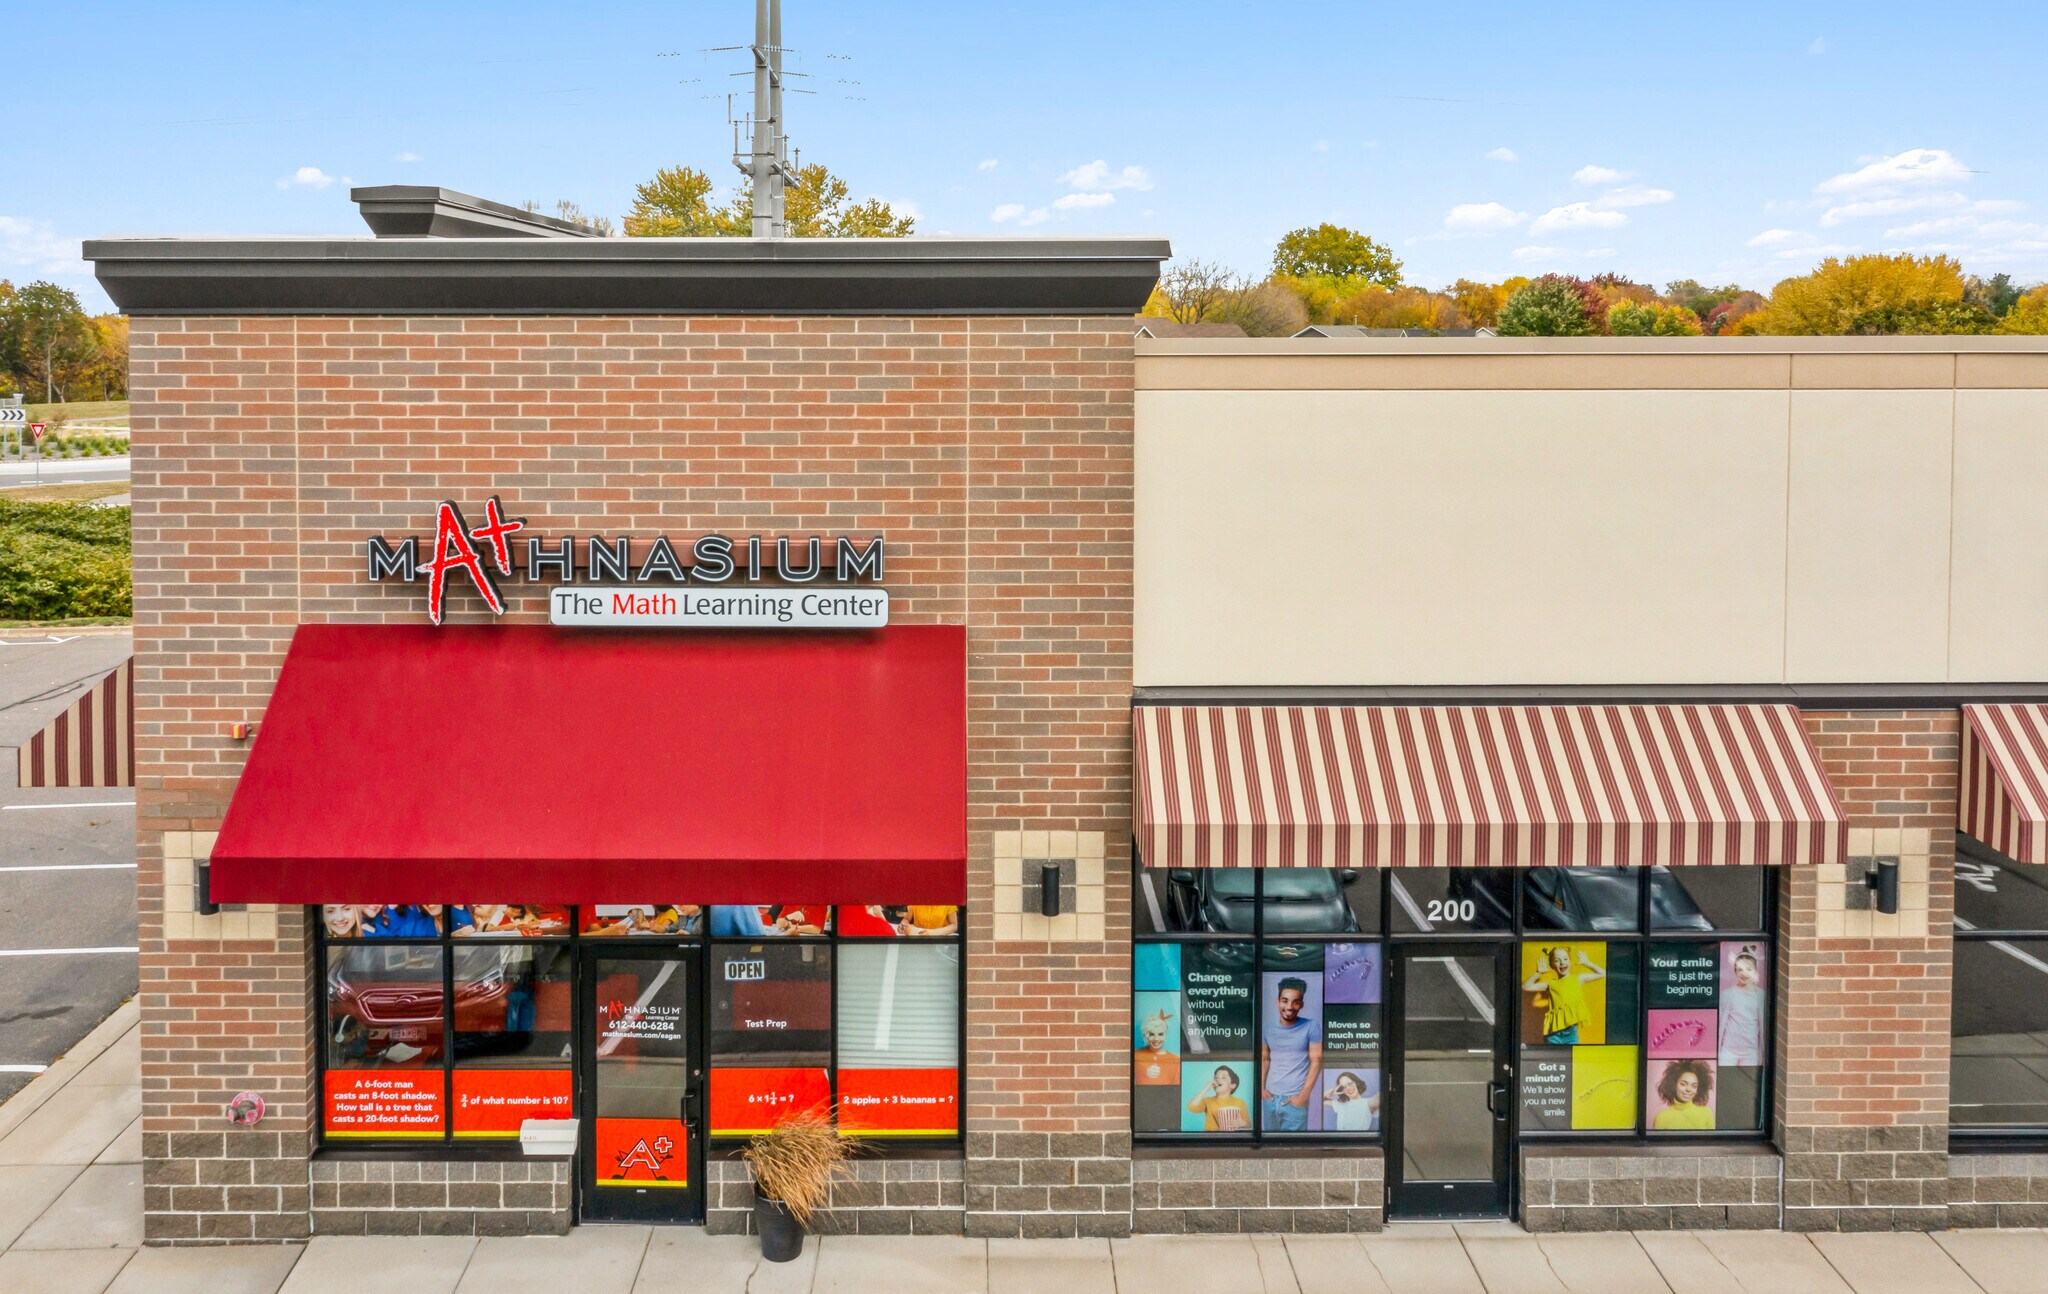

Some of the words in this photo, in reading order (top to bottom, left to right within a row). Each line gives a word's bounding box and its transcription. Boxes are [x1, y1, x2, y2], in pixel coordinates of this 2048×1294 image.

[555, 592, 603, 615] The
[611, 592, 677, 616] Math
[683, 593, 794, 622] Learning
[800, 594, 884, 616] Center
[1427, 899, 1475, 922] 200
[1651, 957, 1679, 968] Your
[1681, 957, 1714, 967] smile
[728, 962, 763, 979] OPEN
[1187, 972, 1233, 985] Change
[1668, 970, 1678, 981] is
[1678, 971, 1696, 983] just
[1697, 971, 1714, 981] the
[1187, 985, 1249, 998] everything
[1666, 984, 1713, 996] beginning
[1187, 999, 1225, 1009] without
[1187, 1012, 1218, 1025] giving
[609, 1020, 674, 1030] 612-440-6284
[745, 1019, 765, 1028] Test
[766, 1019, 788, 1030] Prep
[1328, 1020, 1358, 1029] Moves
[1187, 1026, 1231, 1038] anything
[1233, 1027, 1248, 1038] up
[1328, 1031, 1354, 1039] much
[1328, 1041, 1345, 1049] than
[1345, 1041, 1359, 1051] just
[1538, 1063, 1558, 1072] Got
[1525, 1074, 1566, 1083] minute?
[354, 1080, 363, 1088] A
[364, 1080, 393, 1088] 6-foot
[1543, 1085, 1567, 1094] show
[333, 1092, 357, 1100] casts
[371, 1091, 399, 1100] 8-foot
[401, 1091, 438, 1100] shadow.
[470, 1096, 482, 1105] of
[482, 1096, 505, 1105] what
[507, 1096, 541, 1105] number
[543, 1096, 551, 1105] is
[552, 1096, 569, 1105] 10?
[748, 1094, 755, 1103] 6
[843, 1095, 850, 1104] 2
[851, 1095, 881, 1106] apples
[892, 1095, 898, 1104] 3
[900, 1095, 937, 1104] bananas
[336, 1103, 357, 1111] How
[359, 1103, 374, 1111] tall
[375, 1103, 383, 1111] is
[392, 1103, 412, 1111] tree
[413, 1103, 433, 1111] that
[1524, 1098, 1540, 1107] you
[332, 1115, 356, 1123] casts
[365, 1114, 398, 1123] 20-foot
[399, 1114, 440, 1123] shadow?
